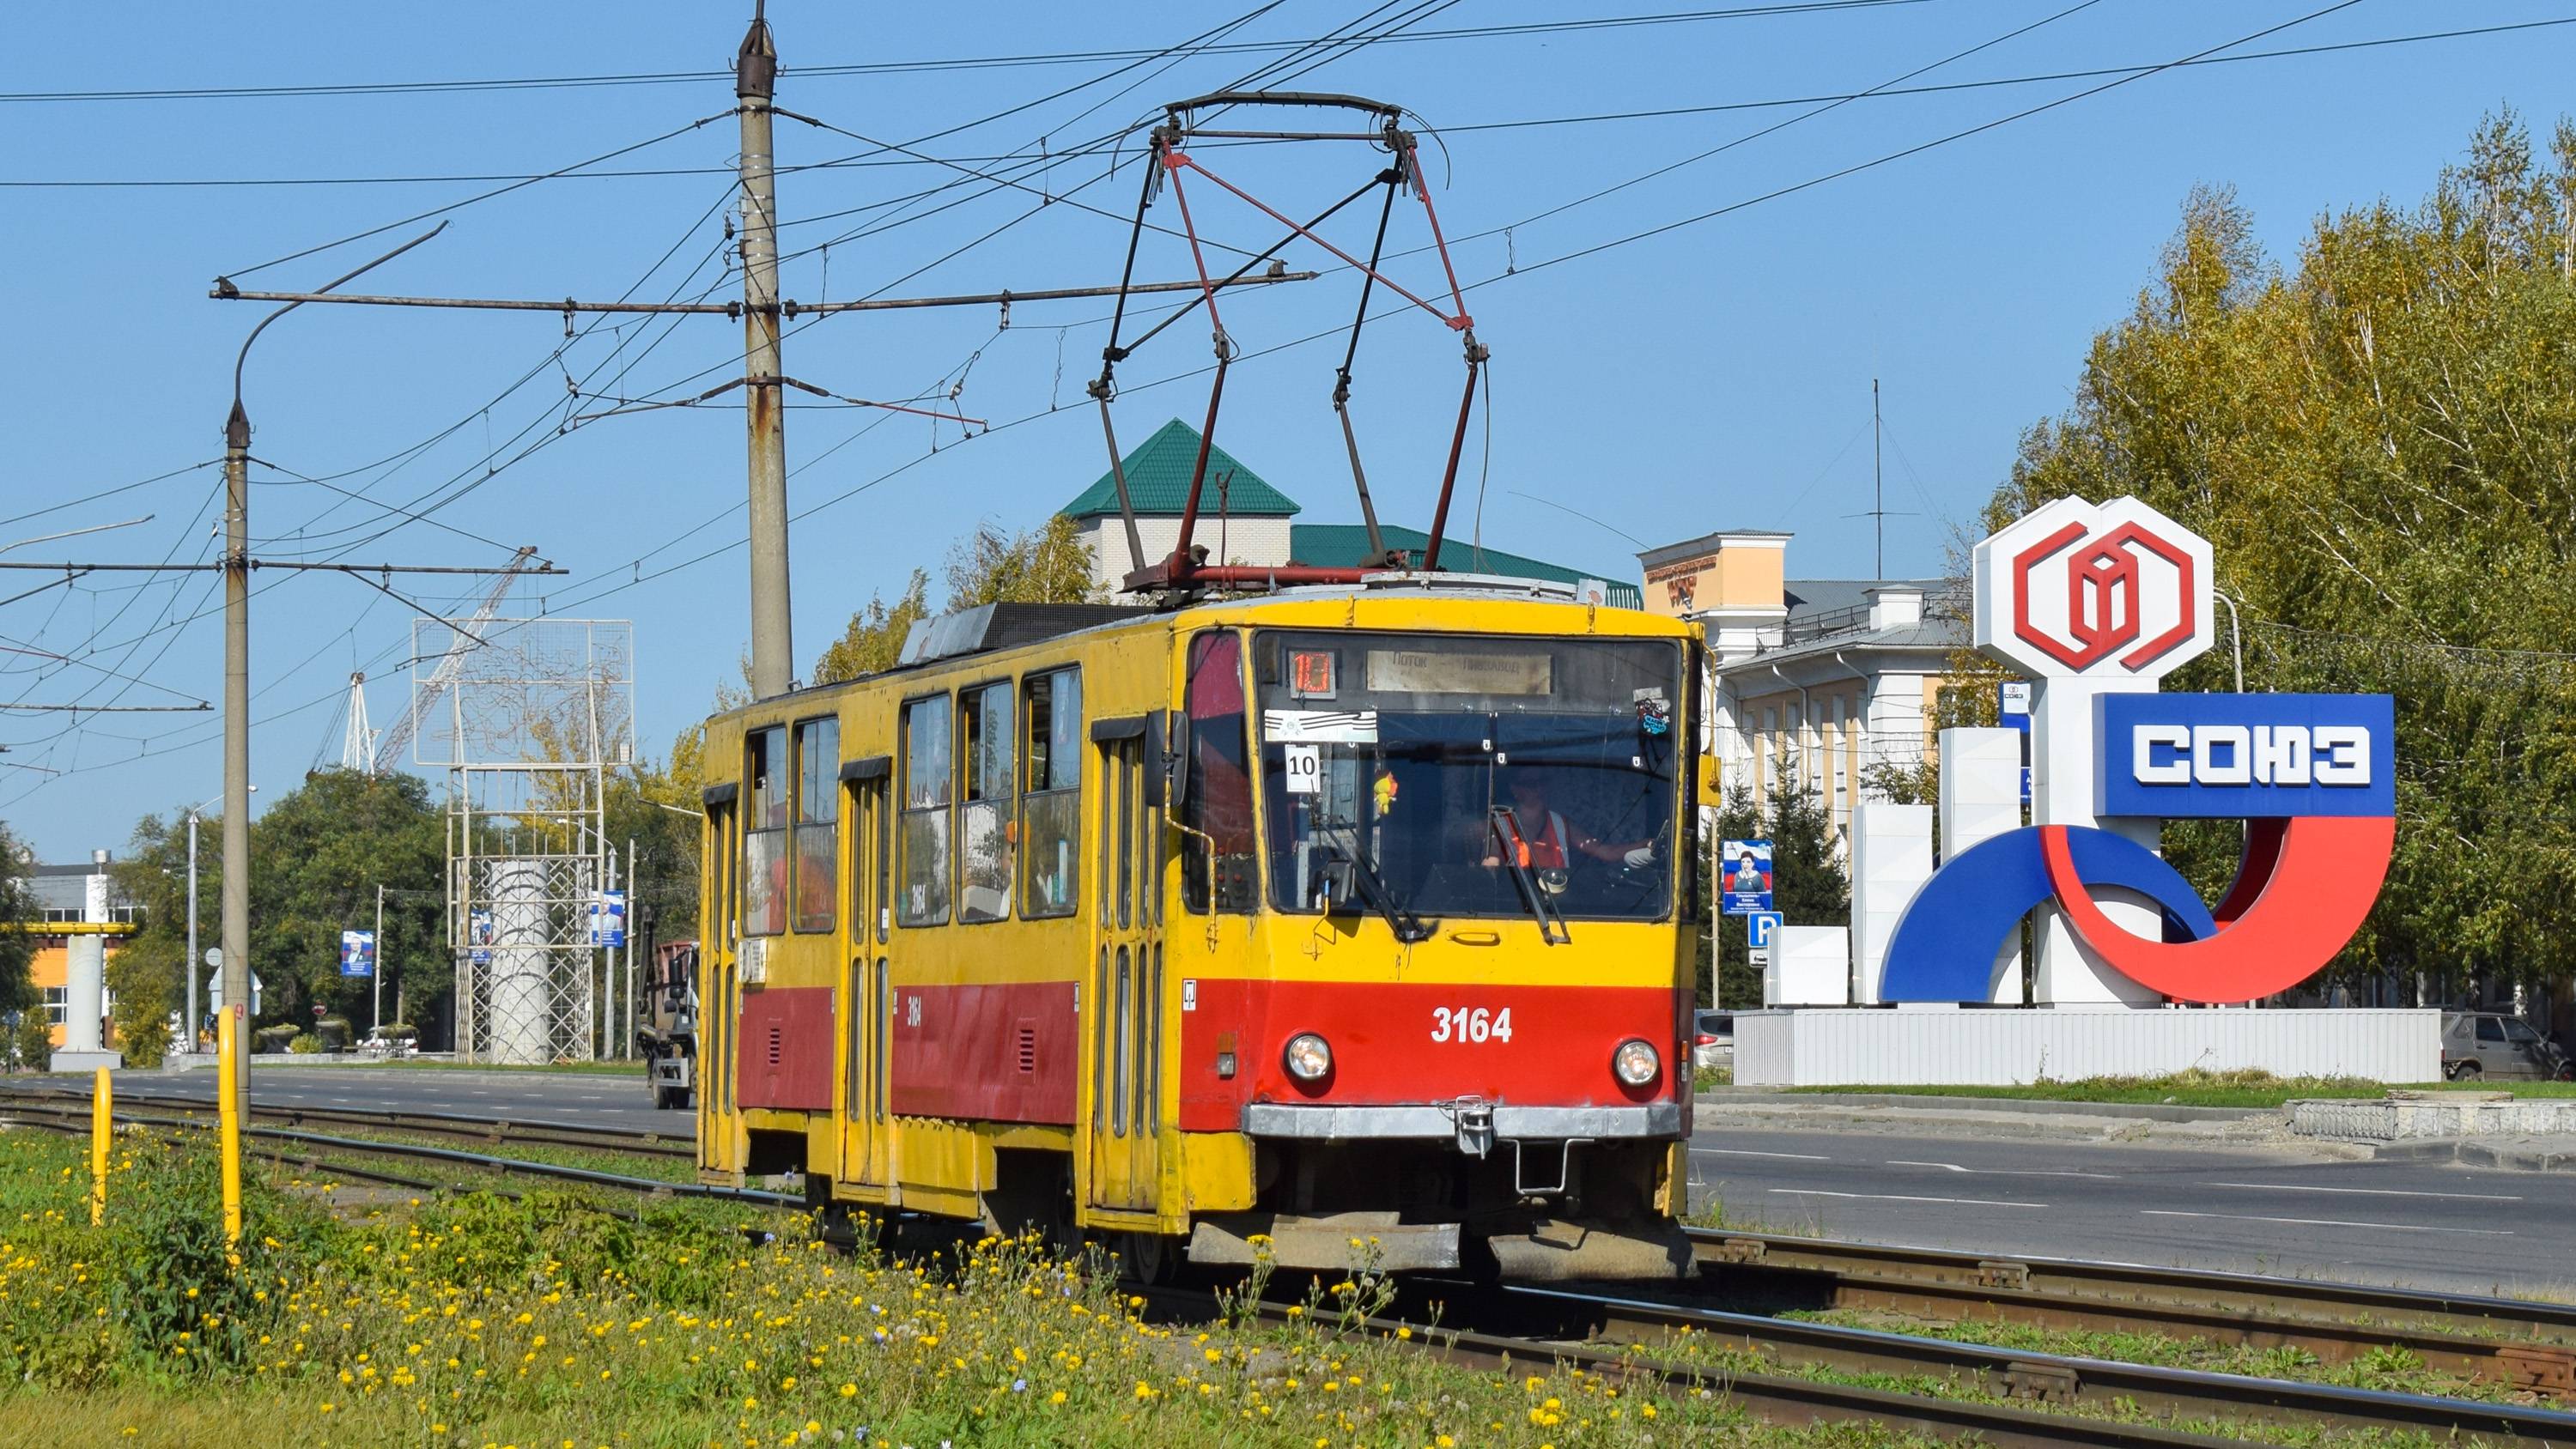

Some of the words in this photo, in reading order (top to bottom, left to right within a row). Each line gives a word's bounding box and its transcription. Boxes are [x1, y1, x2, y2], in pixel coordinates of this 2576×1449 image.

[1289, 755, 1315, 775] 10
[2133, 725, 2371, 786] СОЮЗ
[1758, 916, 1777, 944] P
[908, 996, 921, 1027] 3164
[1431, 1006, 1512, 1043] 3164
